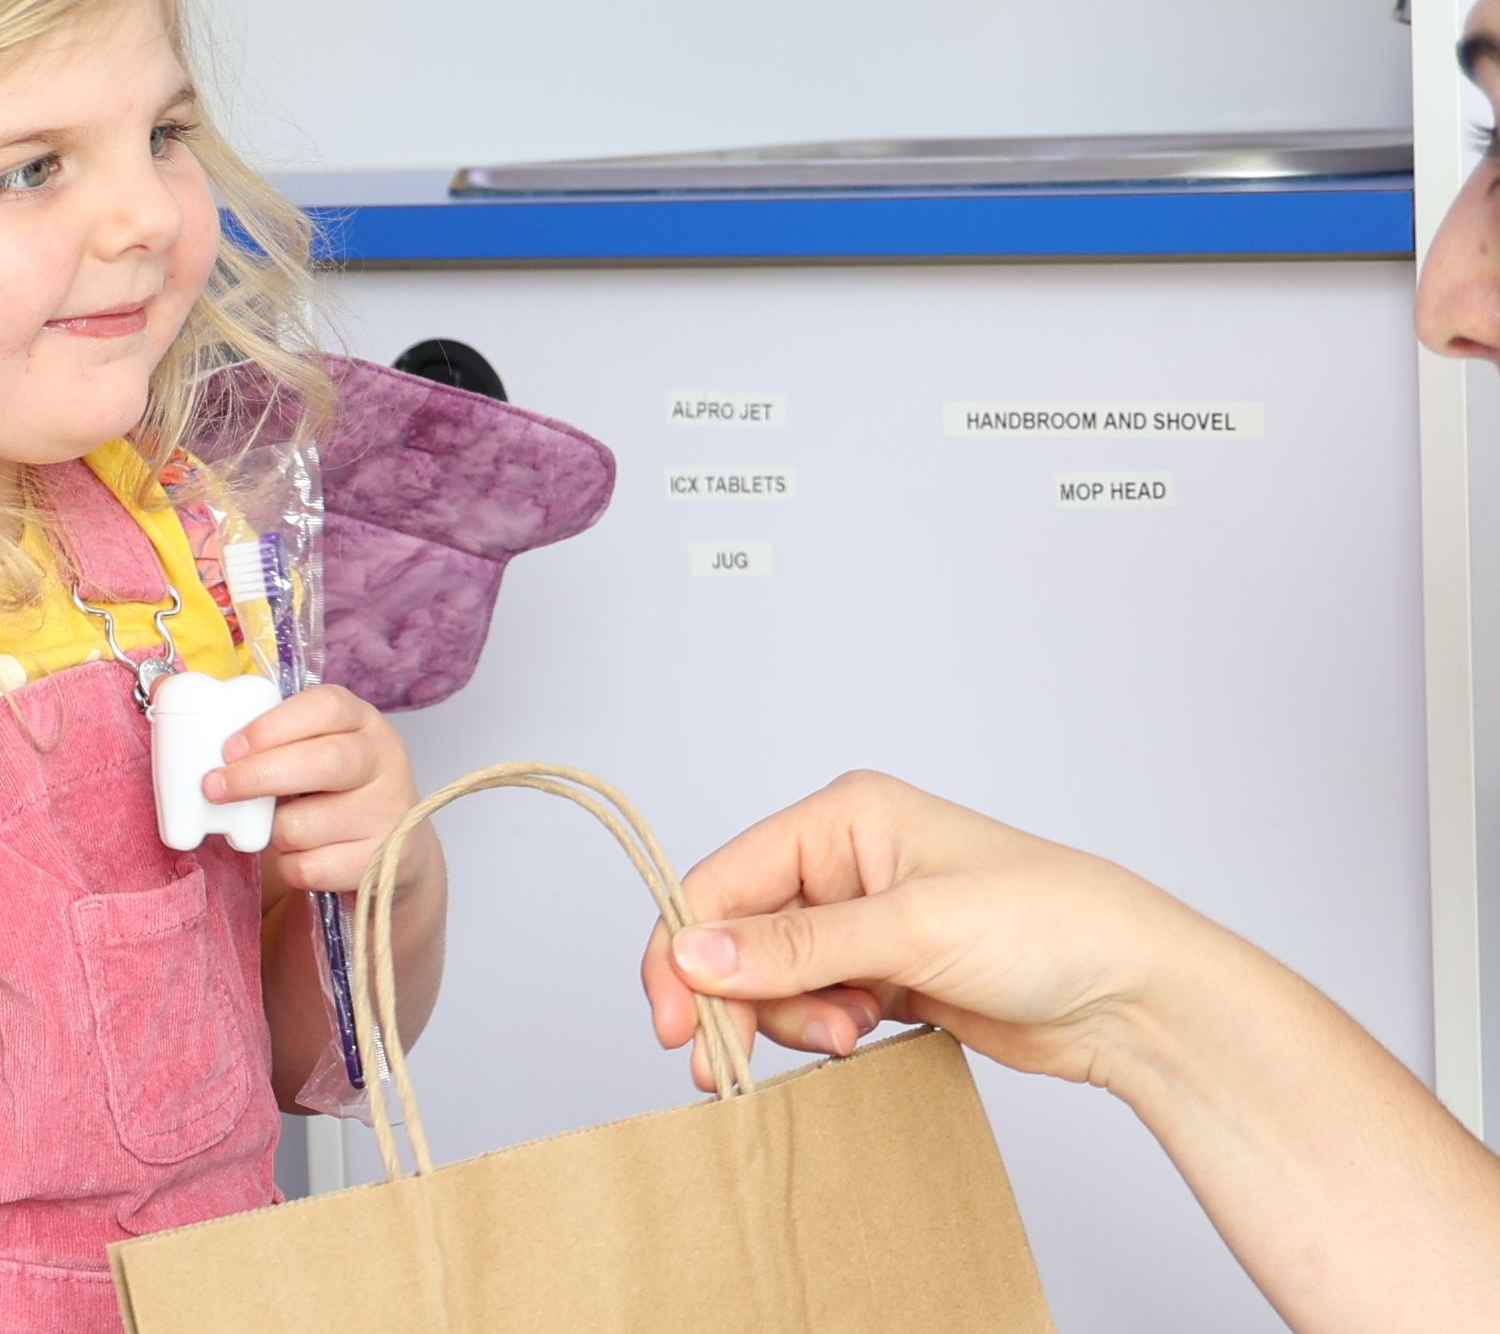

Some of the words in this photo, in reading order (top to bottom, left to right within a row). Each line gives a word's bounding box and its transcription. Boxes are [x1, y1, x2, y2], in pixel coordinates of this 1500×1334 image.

[672, 401, 734, 420] ALPRO
[739, 403, 773, 421] JET
[966, 411, 1098, 430] HANDBROOM
[1103, 411, 1148, 430] AND
[1153, 412, 1237, 432] SHOVEL
[670, 476, 699, 494] ICX
[705, 475, 787, 494] TABLETS
[1059, 482, 1104, 501] MOP
[1110, 481, 1167, 500] HEAD
[711, 551, 749, 570] JUG
